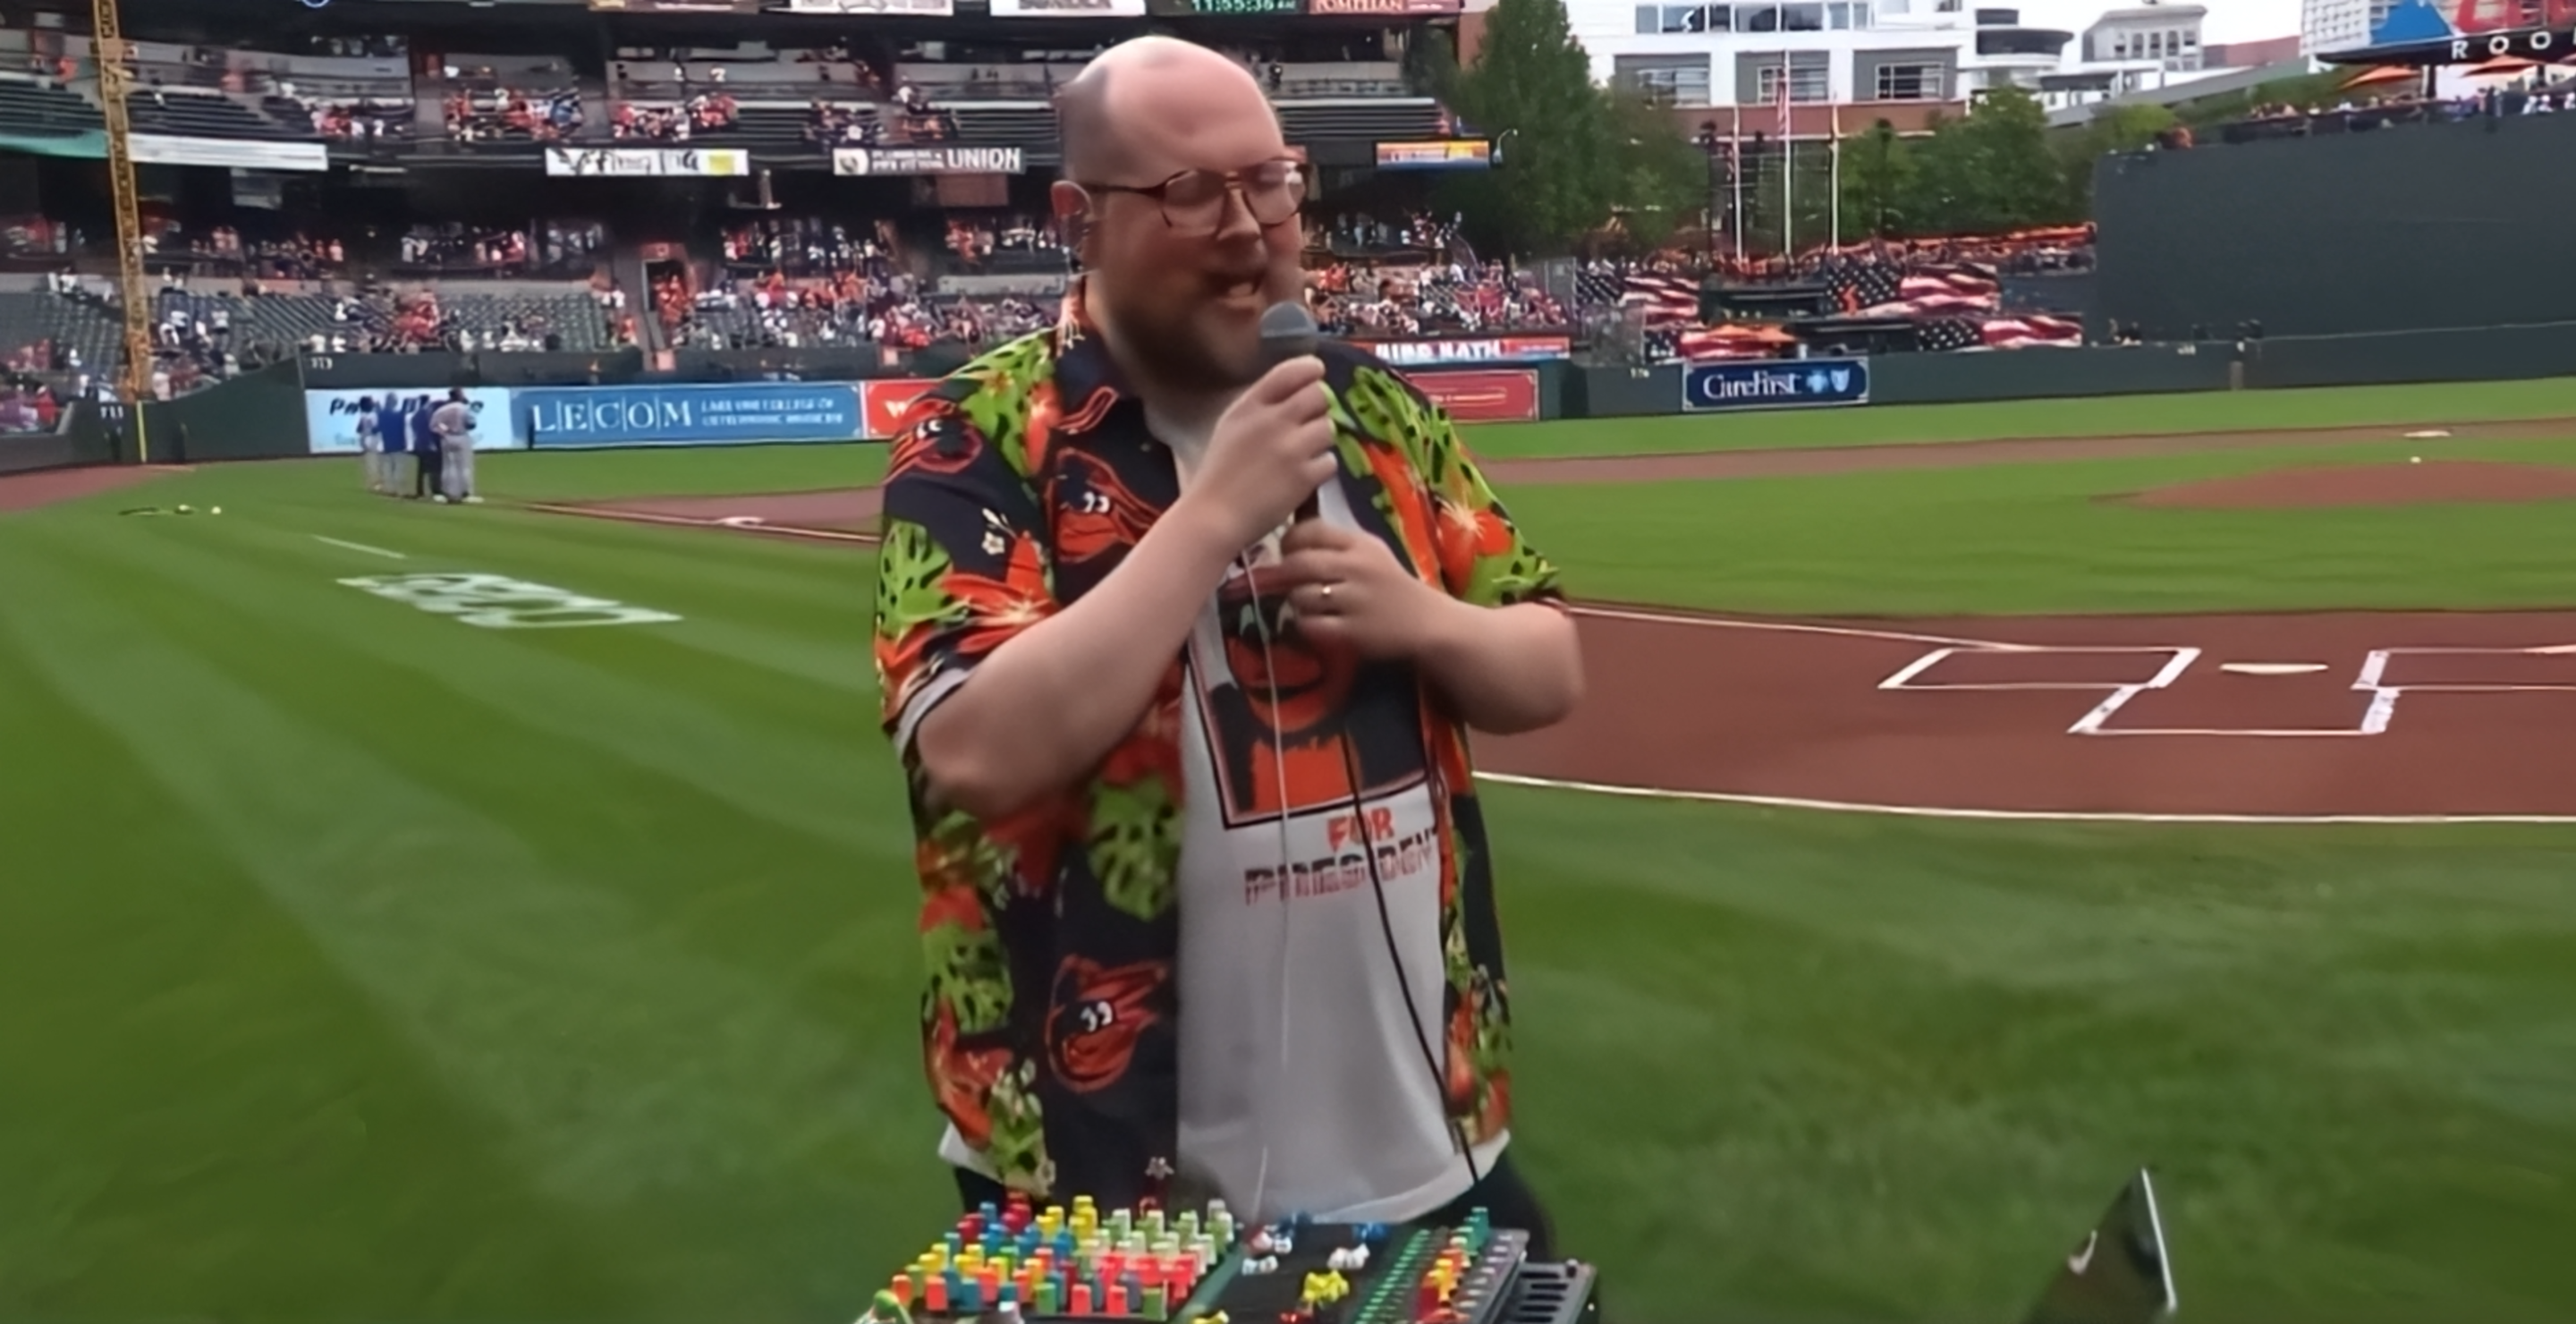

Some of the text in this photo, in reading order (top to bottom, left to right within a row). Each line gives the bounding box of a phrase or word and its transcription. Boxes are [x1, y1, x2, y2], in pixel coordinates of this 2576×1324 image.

[2451, 25, 2576, 60] ROO
[946, 147, 1021, 171] UNION
[1703, 370, 1802, 399] CareFirst
[1244, 828, 1437, 906] PRESDEN
